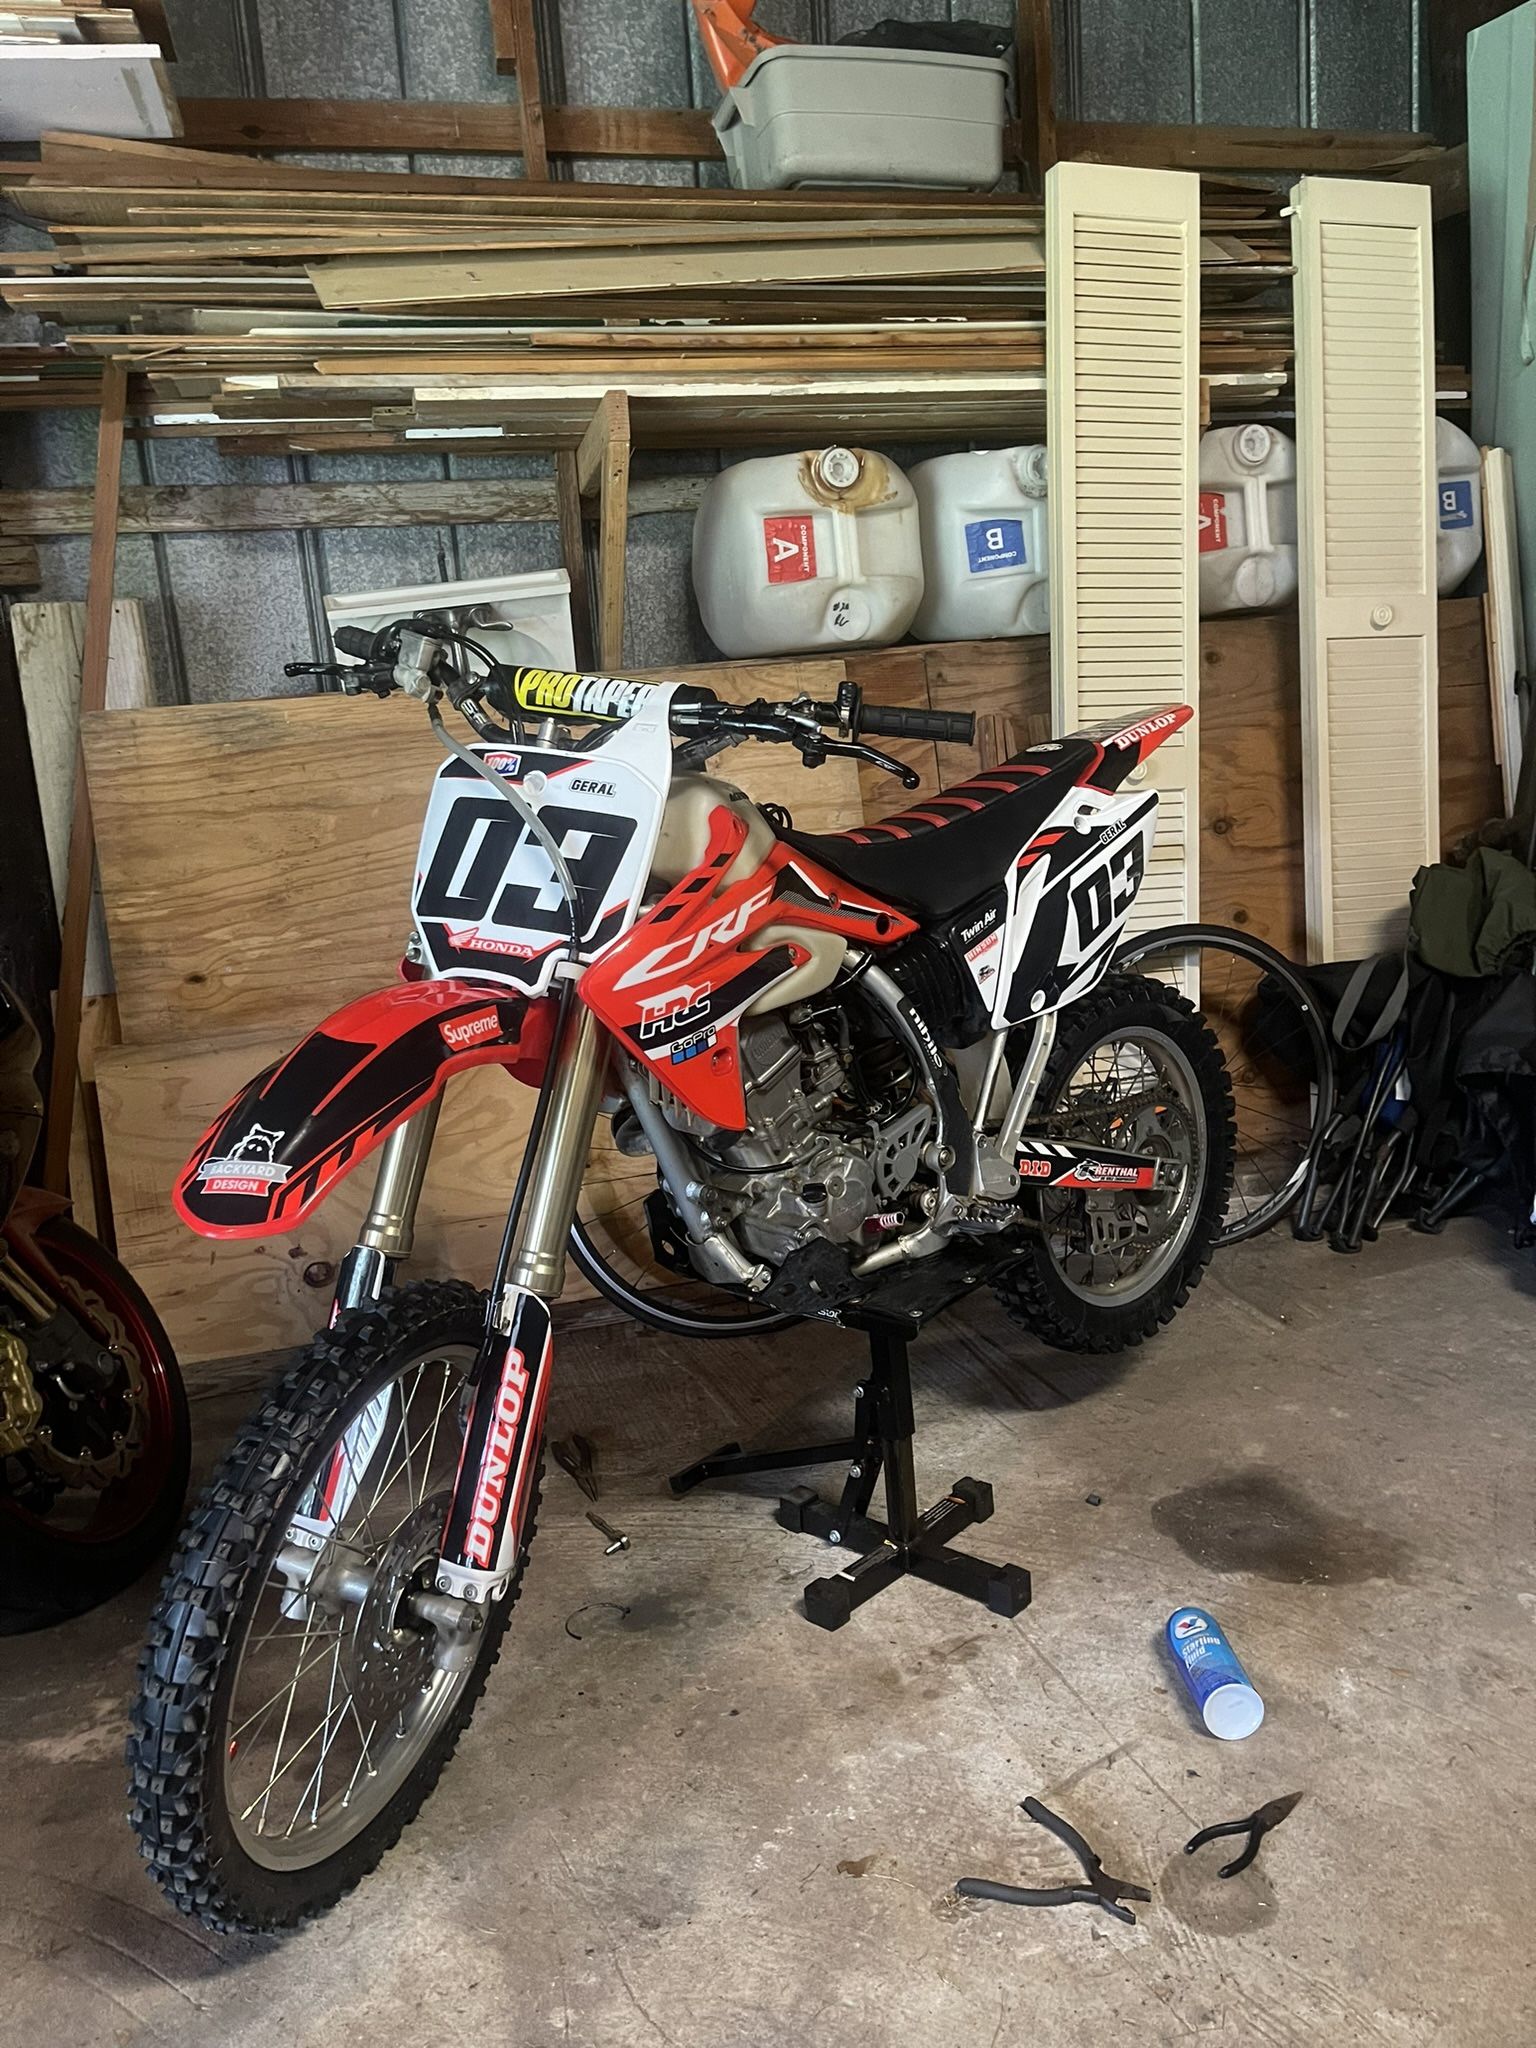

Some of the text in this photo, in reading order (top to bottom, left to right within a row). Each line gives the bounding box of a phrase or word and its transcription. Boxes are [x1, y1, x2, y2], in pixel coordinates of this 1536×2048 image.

[1442, 490, 1457, 511] B
[1213, 498, 1222, 543] COMPONENT
[772, 537, 800, 563] A
[800, 524, 810, 573] COMPONENT
[985, 527, 1004, 551] B
[977, 550, 1018, 564] COMPONENT
[1113, 712, 1177, 751] DUNLOP
[485, 754, 517, 773] 100%
[570, 779, 616, 796] GERAL
[1101, 820, 1126, 843] GERAL
[416, 796, 638, 939] 03
[1070, 830, 1144, 952] 03
[612, 885, 772, 991] CRF
[960, 908, 998, 942] Twin Air
[468, 939, 534, 957] HONDA
[637, 981, 712, 1040] HRC
[443, 1014, 499, 1044] Supreme
[671, 1026, 716, 1053] GoPro
[908, 1007, 943, 1068] nihilo
[209, 1163, 276, 1178] BACKYARD
[1019, 1158, 1052, 1178] DID
[1094, 1166, 1139, 1177] RENTHAL
[212, 1179, 260, 1191] DESIGN
[463, 1346, 530, 1569] DUNLOP
